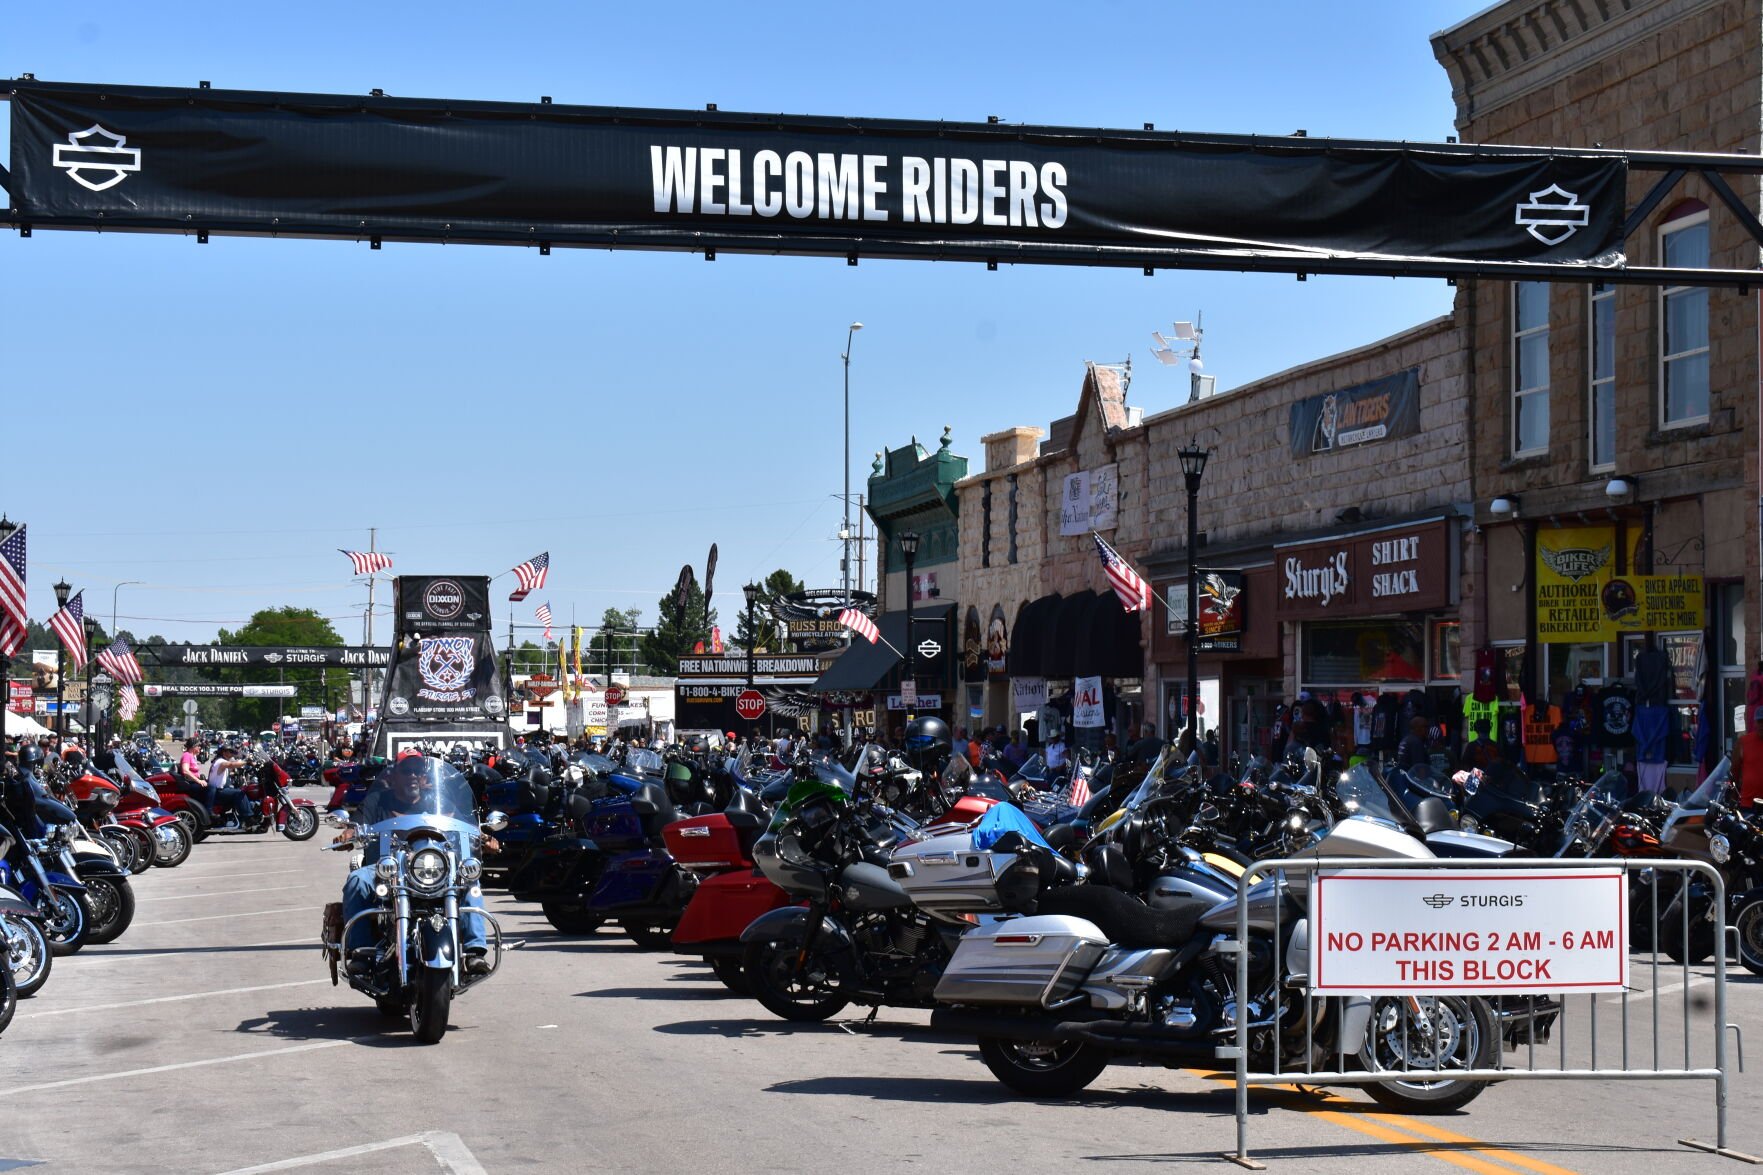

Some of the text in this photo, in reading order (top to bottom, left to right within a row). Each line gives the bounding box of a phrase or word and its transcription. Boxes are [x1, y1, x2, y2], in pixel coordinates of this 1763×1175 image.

[650, 145, 1068, 229] WELCOME RIDERS
[1372, 536, 1420, 566] SHIRT
[1557, 553, 1595, 565] BIKER
[1563, 562, 1589, 571] LIFE
[1372, 569, 1420, 597] SHACK
[1645, 578, 1700, 593] BIKER APPAREL
[1539, 584, 1597, 598] AUTHORIZ
[429, 595, 460, 603] DIXXON
[1539, 599, 1559, 607] BIKER
[1580, 598, 1598, 606] CLOT
[1646, 596, 1685, 609] SOUVENIRS
[1549, 608, 1600, 621] RETAILE
[1646, 612, 1668, 626] GIFTS
[1677, 611, 1697, 625] MORE
[790, 621, 816, 631] RUSS
[1204, 625, 1222, 634] SINCE
[1539, 622, 1600, 632] BIKERLIFE.C
[182, 648, 249, 663] JACK DANIEL'S
[286, 654, 326, 662] STURGIS
[340, 650, 390, 664] JACK DANI
[680, 660, 700, 672] FREE
[757, 659, 810, 672] BREAKDOWN
[605, 692, 621, 700] STOP
[739, 699, 763, 710] STOP
[1461, 895, 1523, 907] STURGIS
[1328, 932, 1363, 951] NO
[1371, 932, 1480, 951] PARKING
[1487, 932, 1499, 951] 2
[1506, 932, 1541, 950] AM
[1562, 931, 1574, 950] 6
[1580, 930, 1614, 949] AM
[1395, 959, 1551, 981] THIS BLOCK
